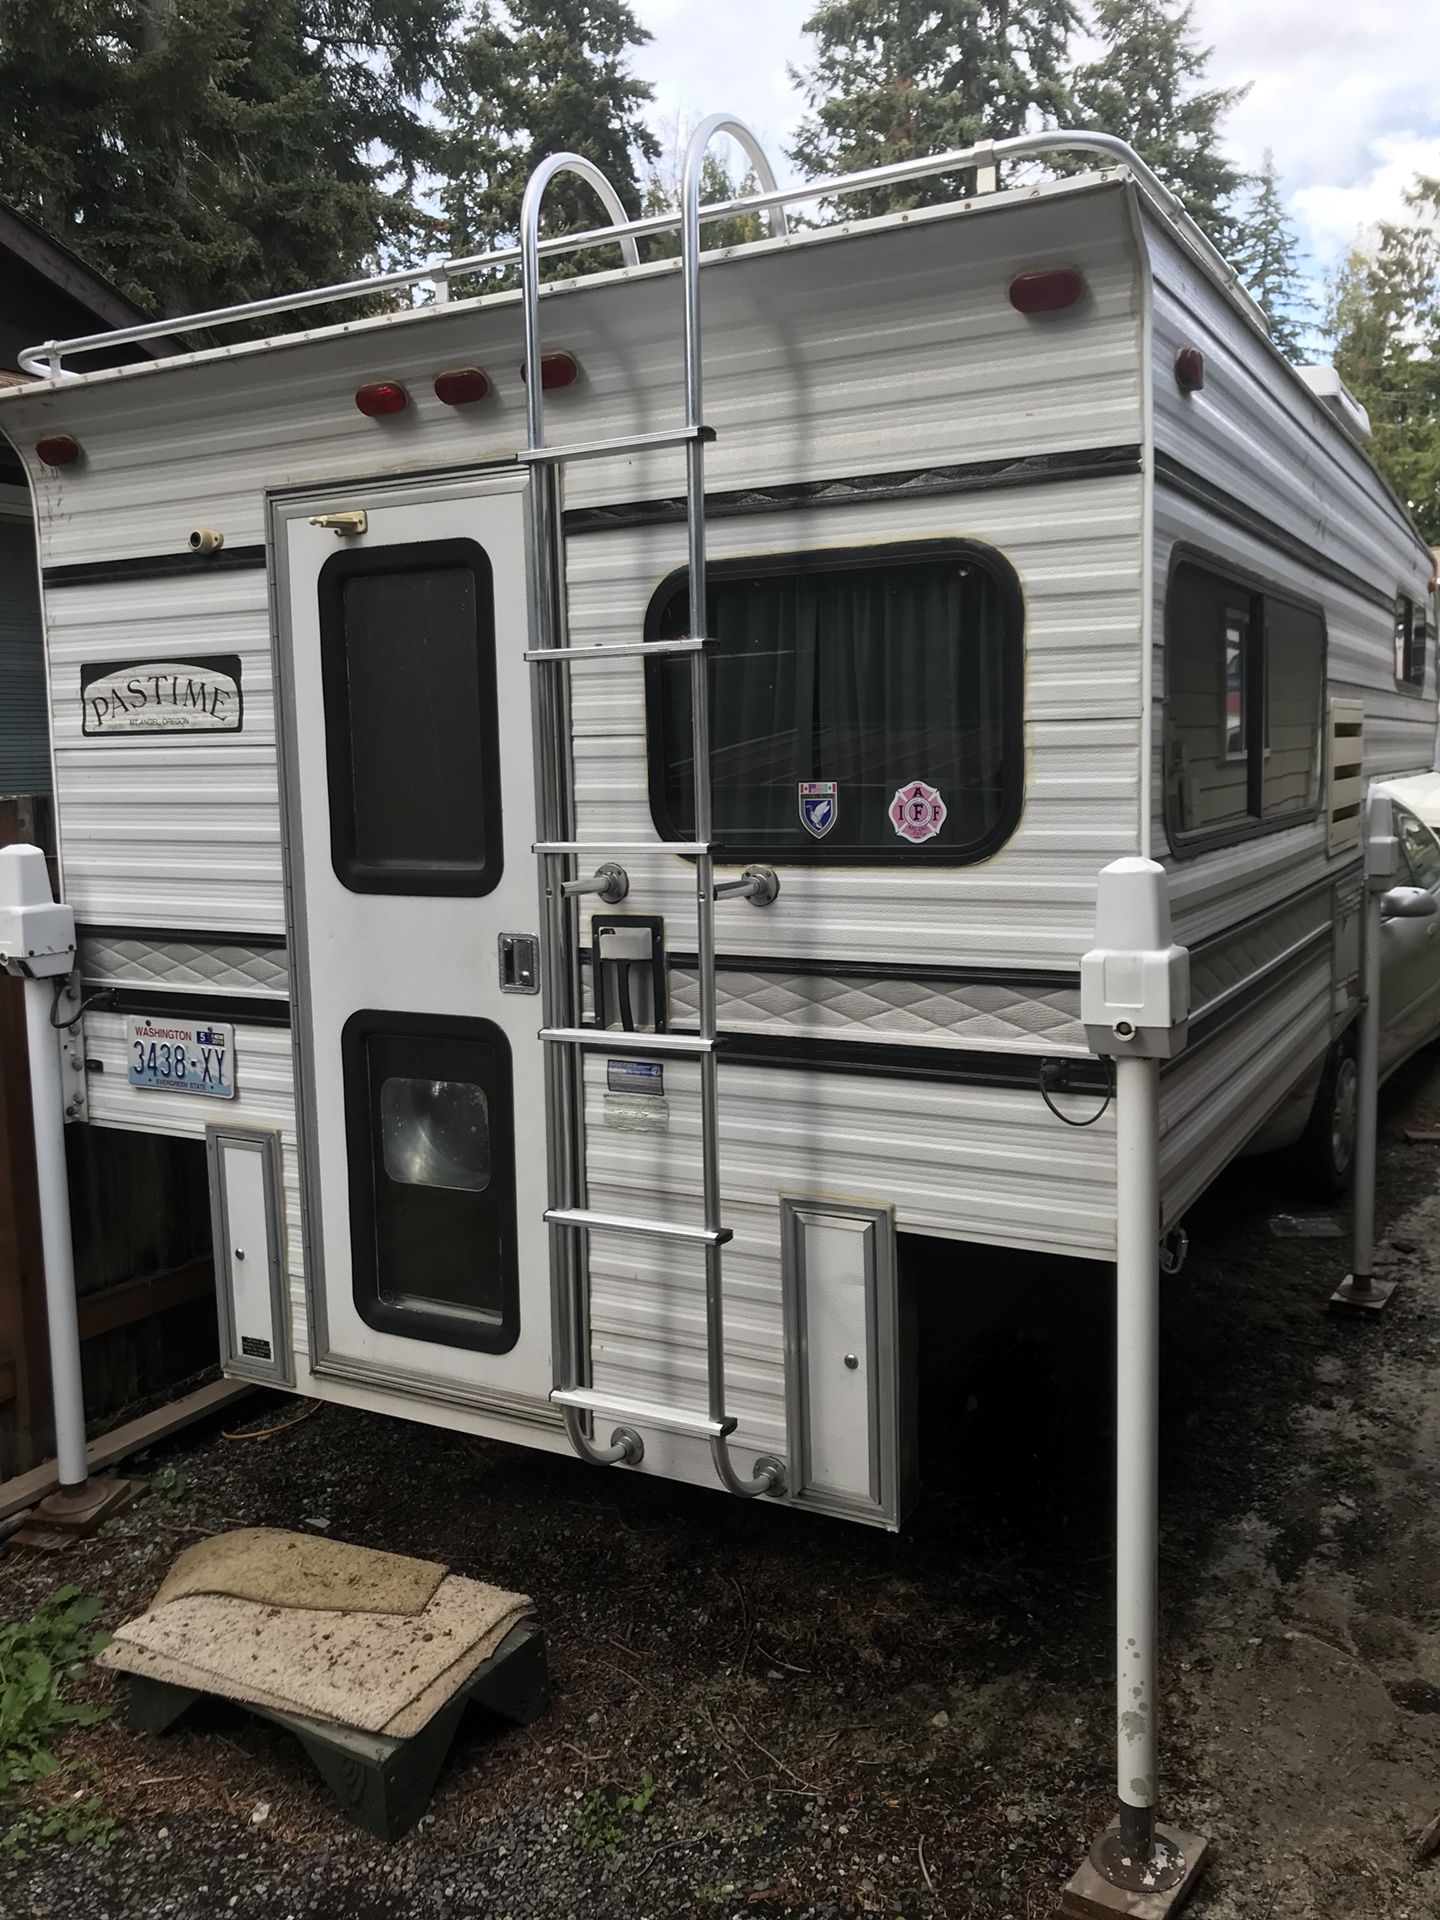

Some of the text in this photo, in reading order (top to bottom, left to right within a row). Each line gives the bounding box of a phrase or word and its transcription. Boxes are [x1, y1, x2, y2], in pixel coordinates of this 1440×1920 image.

[91, 675, 231, 727] PASTIME
[162, 717, 190, 725] OREGON
[912, 787, 924, 798] A
[134, 1026, 192, 1041] WASHINGTON
[200, 1032, 206, 1041] 5
[133, 1039, 226, 1084] 3438-XY
[156, 1079, 207, 1090] EVERGREEN STATE
